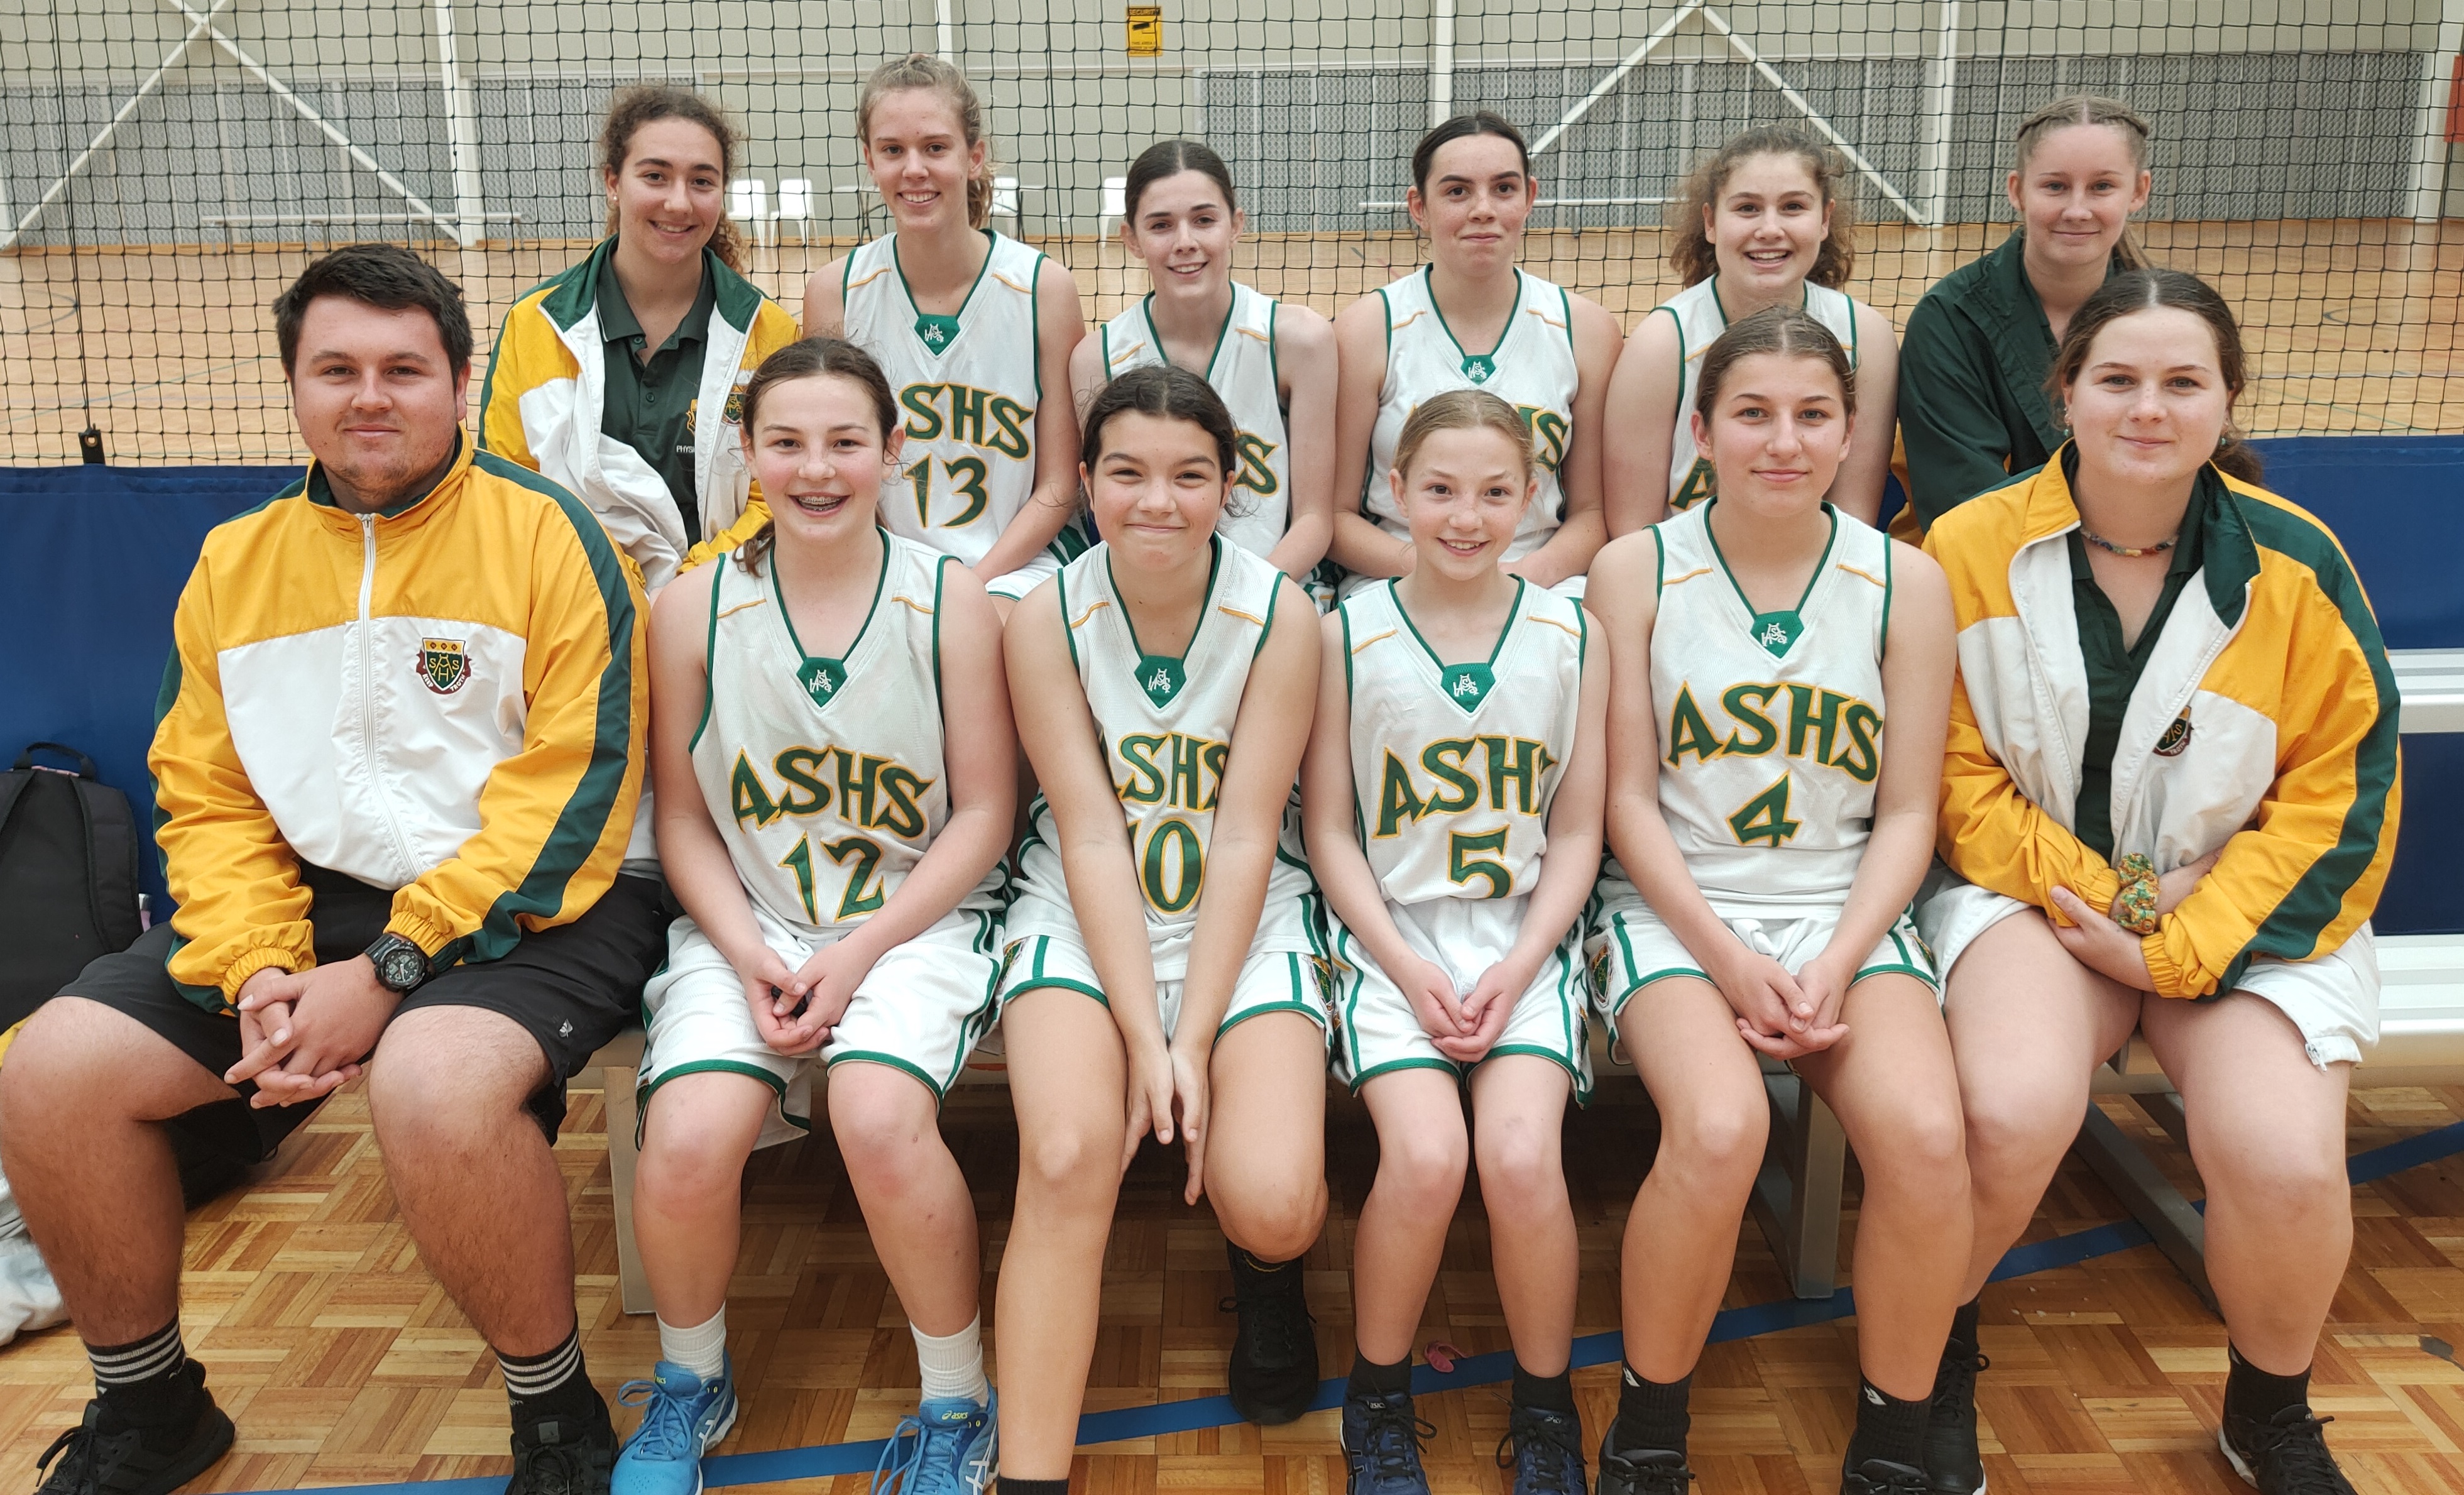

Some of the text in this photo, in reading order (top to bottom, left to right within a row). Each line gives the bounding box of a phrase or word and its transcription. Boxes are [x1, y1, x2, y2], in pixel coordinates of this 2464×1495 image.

[899, 382, 1034, 462] SHS
[904, 452, 989, 529] 13
[1663, 681, 1883, 786] ASHS
[731, 744, 936, 841] ASHS
[1726, 769, 1803, 847] 4
[779, 832, 886, 925] 12
[1127, 817, 1205, 914] 0
[1448, 822, 1514, 899] 5
